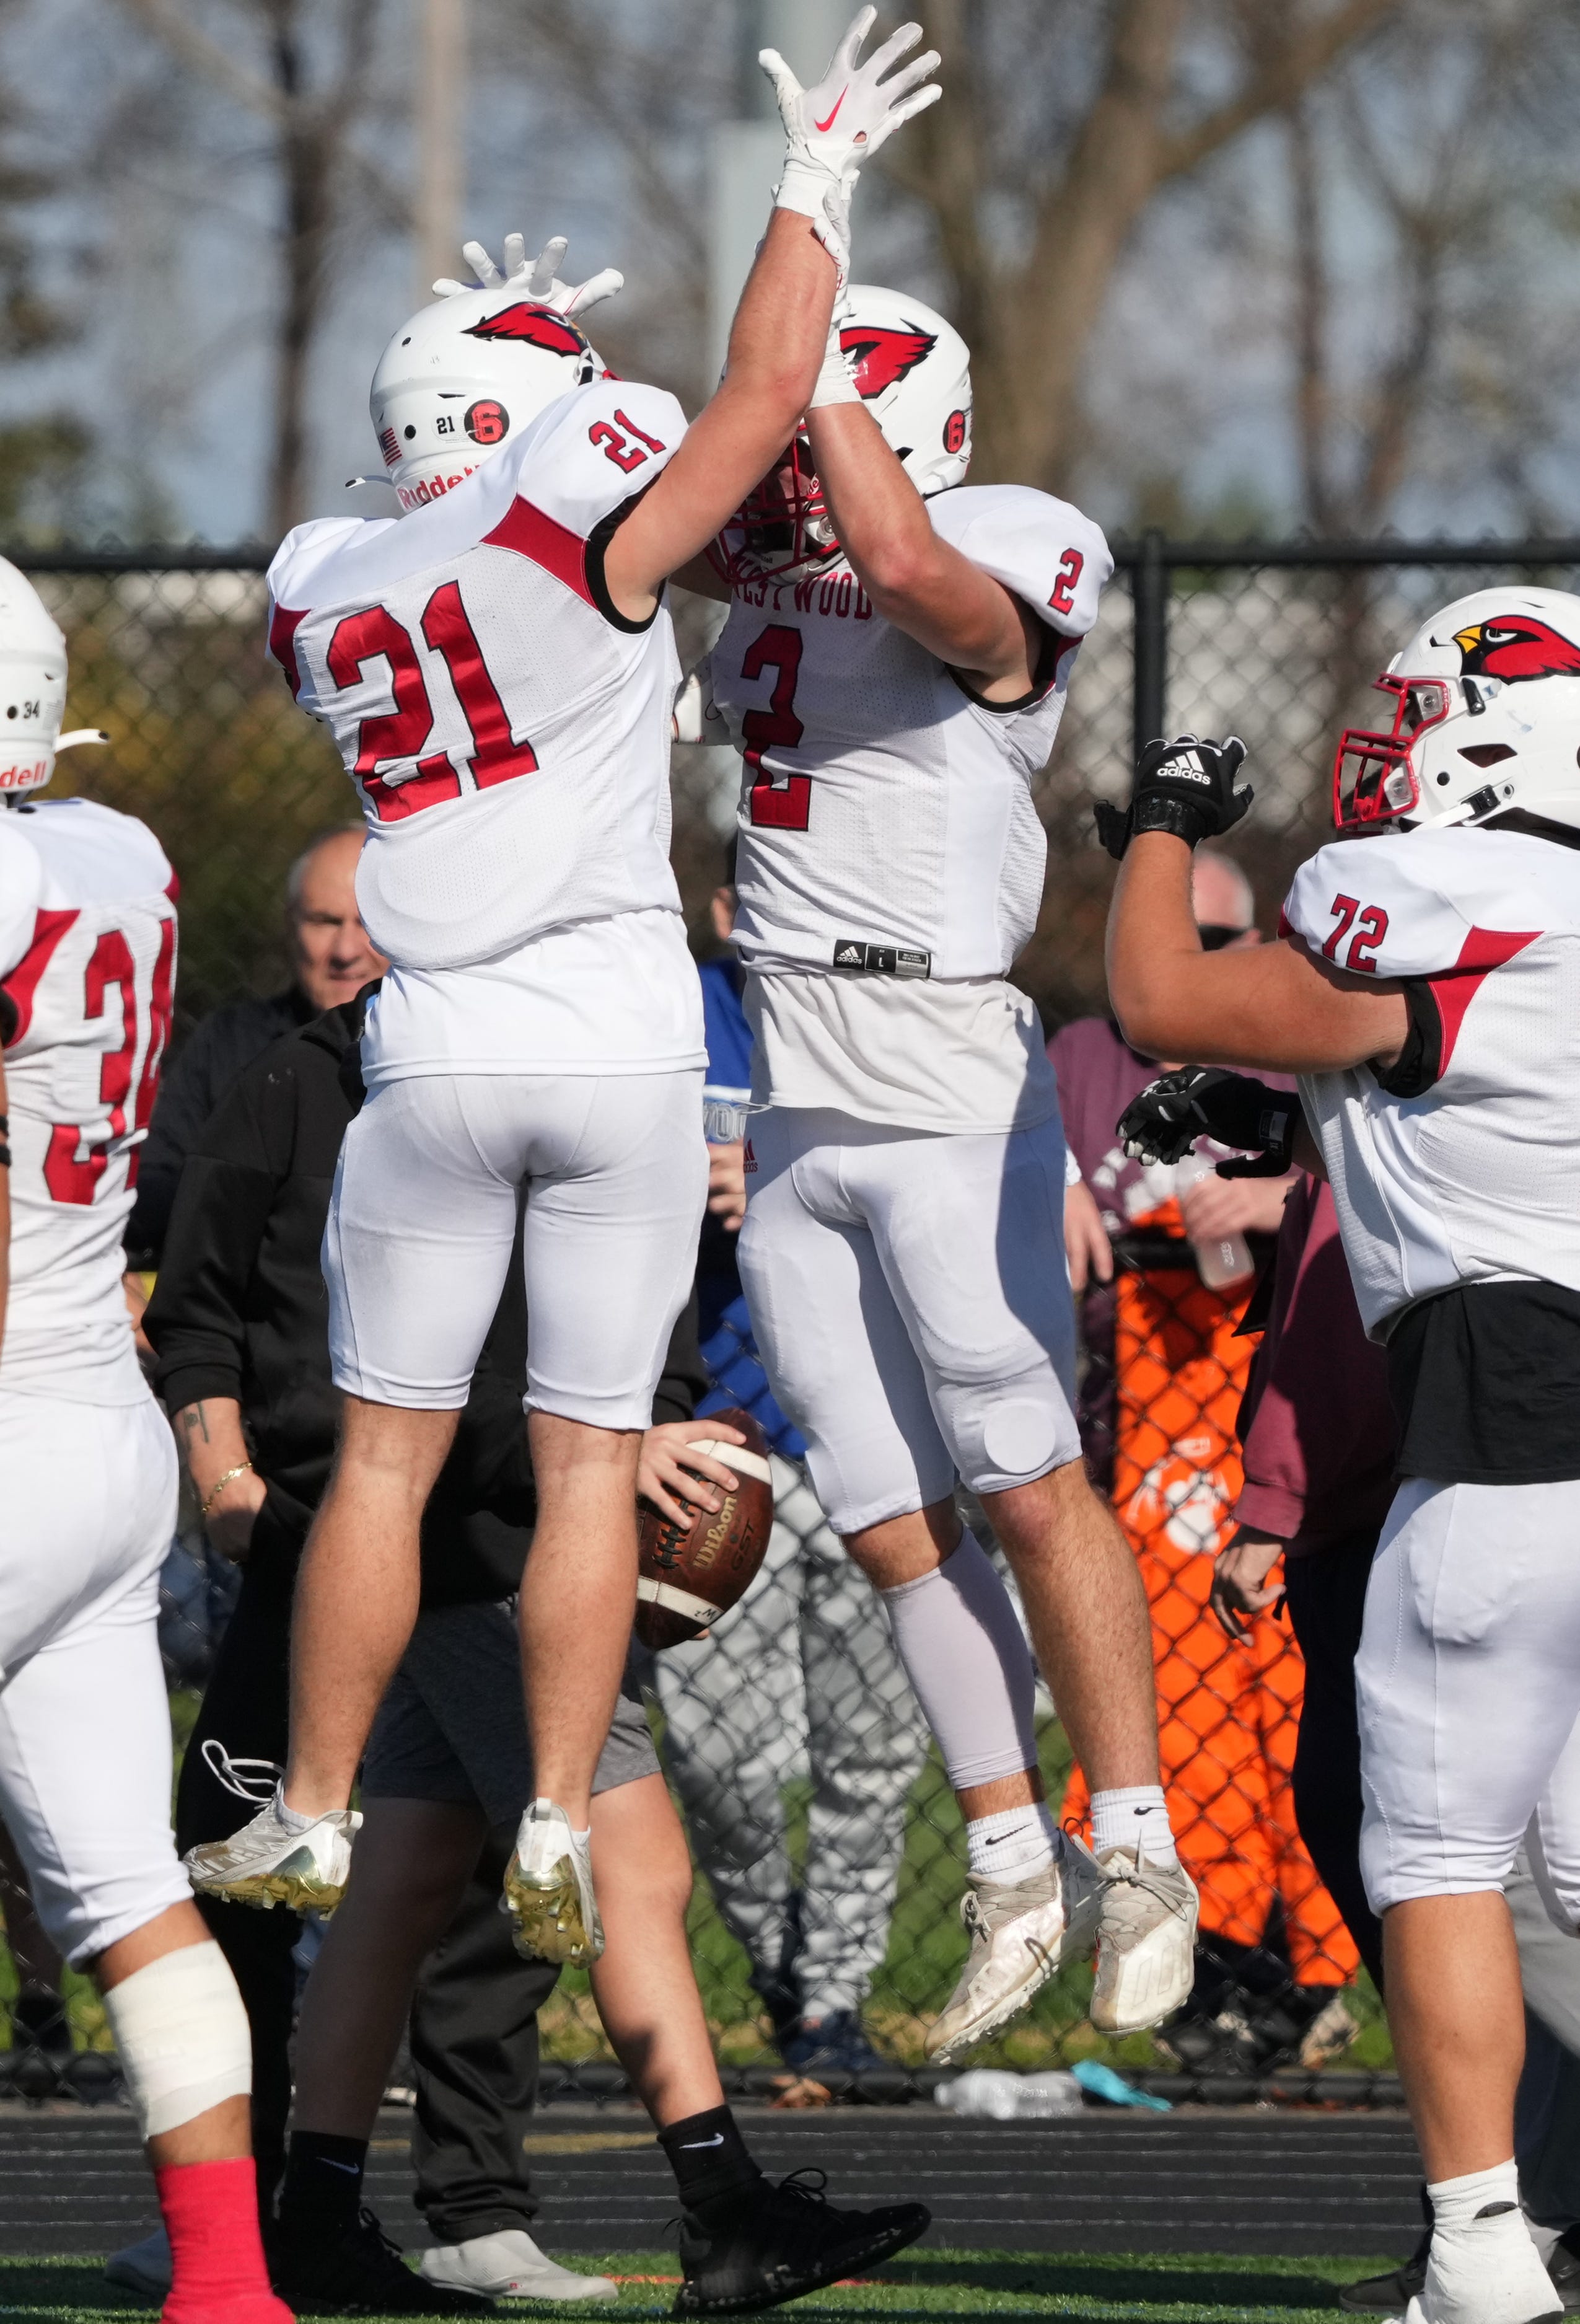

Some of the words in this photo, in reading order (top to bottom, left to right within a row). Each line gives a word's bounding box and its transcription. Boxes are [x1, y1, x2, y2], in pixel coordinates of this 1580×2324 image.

[436, 416, 455, 434] 21
[588, 408, 667, 474] 21
[397, 465, 480, 509] Ridde
[1047, 547, 1084, 616] 2
[24, 699, 40, 719] 34
[326, 579, 540, 822] 21
[740, 623, 812, 832] 2
[0, 760, 46, 788] dell
[1156, 766, 1211, 785] adidas
[1322, 892, 1389, 973] 72
[836, 956, 862, 964] adidas
[877, 956, 884, 967] L
[692, 1496, 737, 1570] Wilson
[731, 1516, 755, 1570] GST
